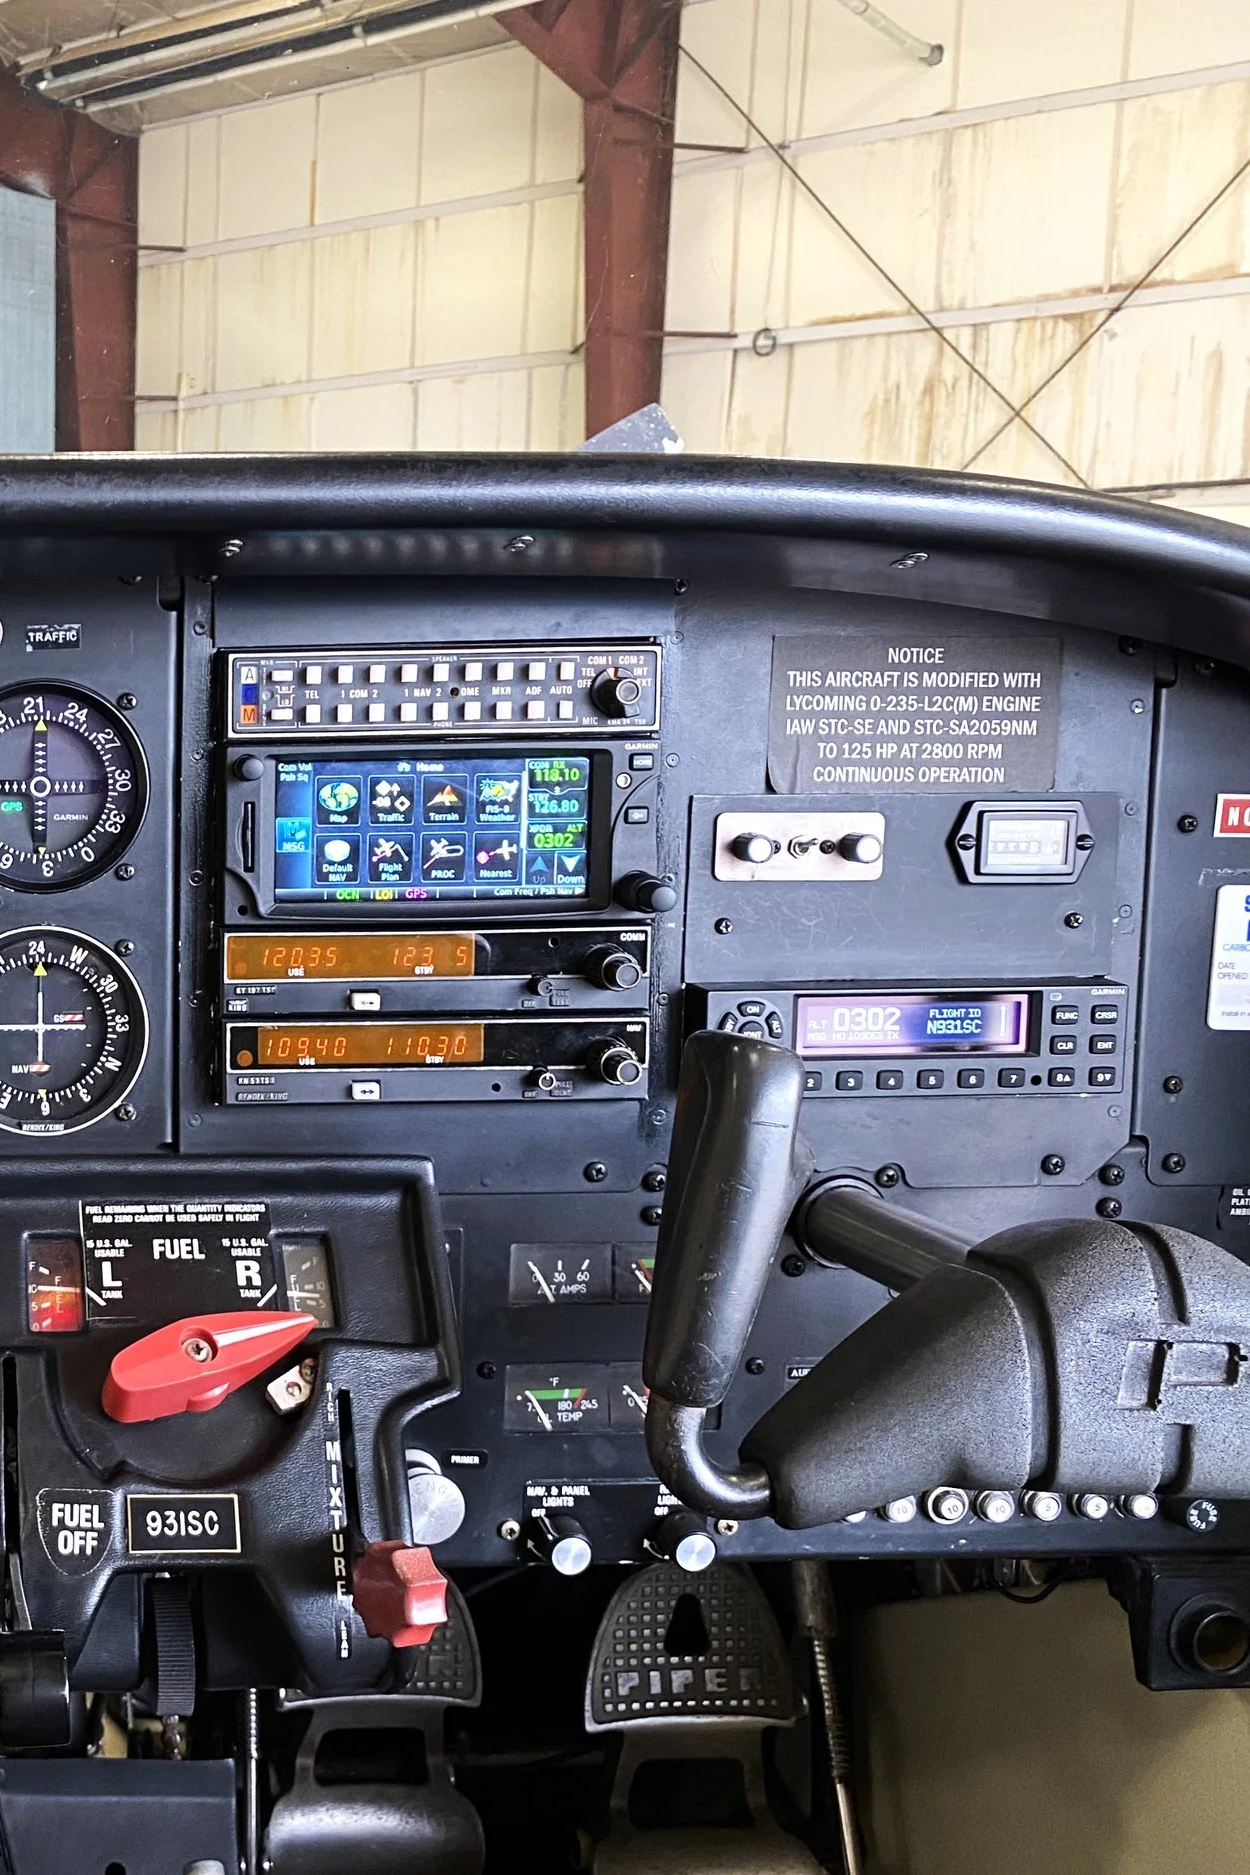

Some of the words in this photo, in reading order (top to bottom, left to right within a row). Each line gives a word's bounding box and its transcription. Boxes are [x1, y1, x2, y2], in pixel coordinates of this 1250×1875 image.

[28, 631, 77, 643] TRAFFIC
[888, 648, 944, 663] NOTICE
[581, 668, 596, 677] TEL
[634, 667, 648, 676] INT
[577, 679, 592, 688] OFF
[787, 671, 822, 687] THIS
[825, 671, 900, 687] AIRCRAFT
[903, 672, 918, 687] IS
[923, 672, 999, 688] MODIFIED
[1003, 673, 1041, 688] WITH
[304, 690, 319, 699] TEL
[349, 689, 368, 698] COM
[413, 689, 431, 697] NAV
[461, 687, 480, 696] DME
[492, 686, 511, 695] MKR
[525, 686, 542, 695] ADF
[550, 686, 572, 695] AUTO
[23, 697, 44, 713] 21
[786, 696, 866, 711] LYCOMING
[982, 696, 1040, 711] ENGINE
[786, 719, 815, 735] IAW
[819, 719, 874, 735] STC-SE
[877, 719, 910, 735] AND
[914, 720, 1037, 735] STC-SA2059NM
[818, 743, 837, 758] TO
[842, 743, 872, 758] 125
[876, 743, 897, 758] HP
[900, 743, 919, 758] AT
[922, 743, 963, 758] 2800
[967, 744, 1002, 758] RPM
[416, 762, 444, 772] Home
[813, 767, 914, 782] CONTINUOUS
[918, 767, 1005, 782] OPERATION
[0, 802, 24, 812] GPS
[377, 813, 405, 822] Traffic
[429, 813, 460, 821] Terrain
[534, 834, 573, 848] 0302
[480, 869, 512, 878] Nearest
[557, 874, 584, 884] Down
[405, 889, 428, 899] GPS
[494, 889, 512, 897] Com
[514, 888, 533, 899] Freq
[28, 940, 45, 955] 24
[1218, 962, 1235, 970] DATE
[1217, 972, 1247, 980] OPENED
[929, 1008, 966, 1018] FLIGHT
[968, 1008, 982, 1018] ID
[1055, 1011, 1078, 1020] FUNC
[1095, 1011, 1118, 1020] CRSR
[833, 1007, 900, 1031] 0302
[927, 1020, 982, 1034] N931SC
[86, 1205, 103, 1214] FUEL
[105, 1205, 145, 1213] REMAINING
[147, 1205, 169, 1213] WHEN
[170, 1205, 184, 1213] THE
[186, 1205, 222, 1213] QUANTITY
[224, 1204, 265, 1212] INDICATORS
[93, 1215, 113, 1223] READ
[135, 1214, 163, 1222] CANNOT
[165, 1214, 175, 1222] BE
[177, 1214, 196, 1222] USED
[198, 1214, 223, 1222] SAFELY
[226, 1214, 234, 1222] IN
[236, 1214, 259, 1222] FLIGHT
[114, 1239, 133, 1247] GAL.
[233, 1238, 248, 1246] U.S.
[250, 1238, 268, 1246] GAL.
[94, 1249, 124, 1258] USABLE
[152, 1238, 205, 1260] FUEL
[231, 1248, 261, 1256] USABLE
[101, 1261, 122, 1287] L
[235, 1260, 262, 1286] R
[554, 1272, 566, 1282] 30
[239, 1289, 261, 1298] TANK
[560, 1284, 587, 1294] AMPS
[101, 1290, 123, 1299] TANK
[326, 1382, 334, 1422] RICH
[557, 1412, 583, 1421] TEMP
[451, 1455, 480, 1464] PRIMER
[562, 1486, 590, 1496] PANEL
[542, 1497, 574, 1507] LIGHTS
[52, 1503, 104, 1528] FUEL
[325, 1441, 347, 1600] MIXTURE
[146, 1511, 219, 1538] 931SC
[57, 1530, 98, 1555] OFF
